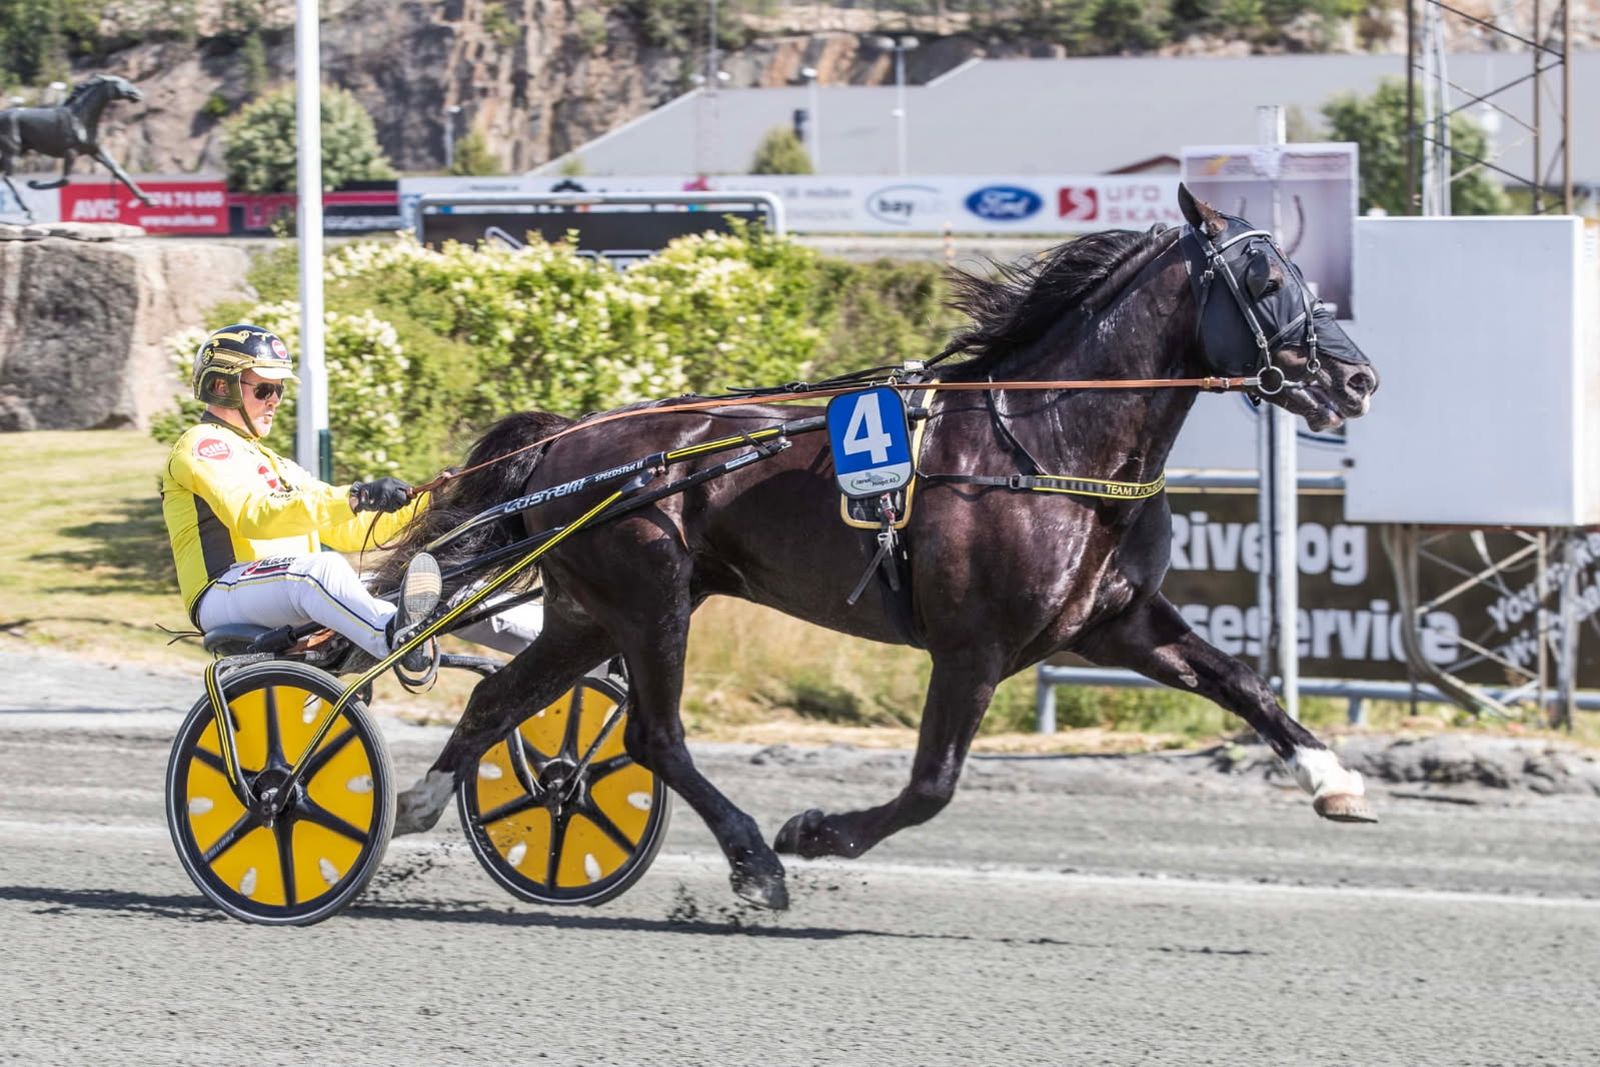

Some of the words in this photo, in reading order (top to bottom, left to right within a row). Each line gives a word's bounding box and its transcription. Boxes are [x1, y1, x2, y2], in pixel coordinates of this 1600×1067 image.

[72, 199, 121, 220] AVIS
[843, 392, 893, 465] 4
[594, 463, 636, 482] SPEEDSTER
[1105, 484, 1133, 496] TEAM
[1296, 522, 1368, 586] og
